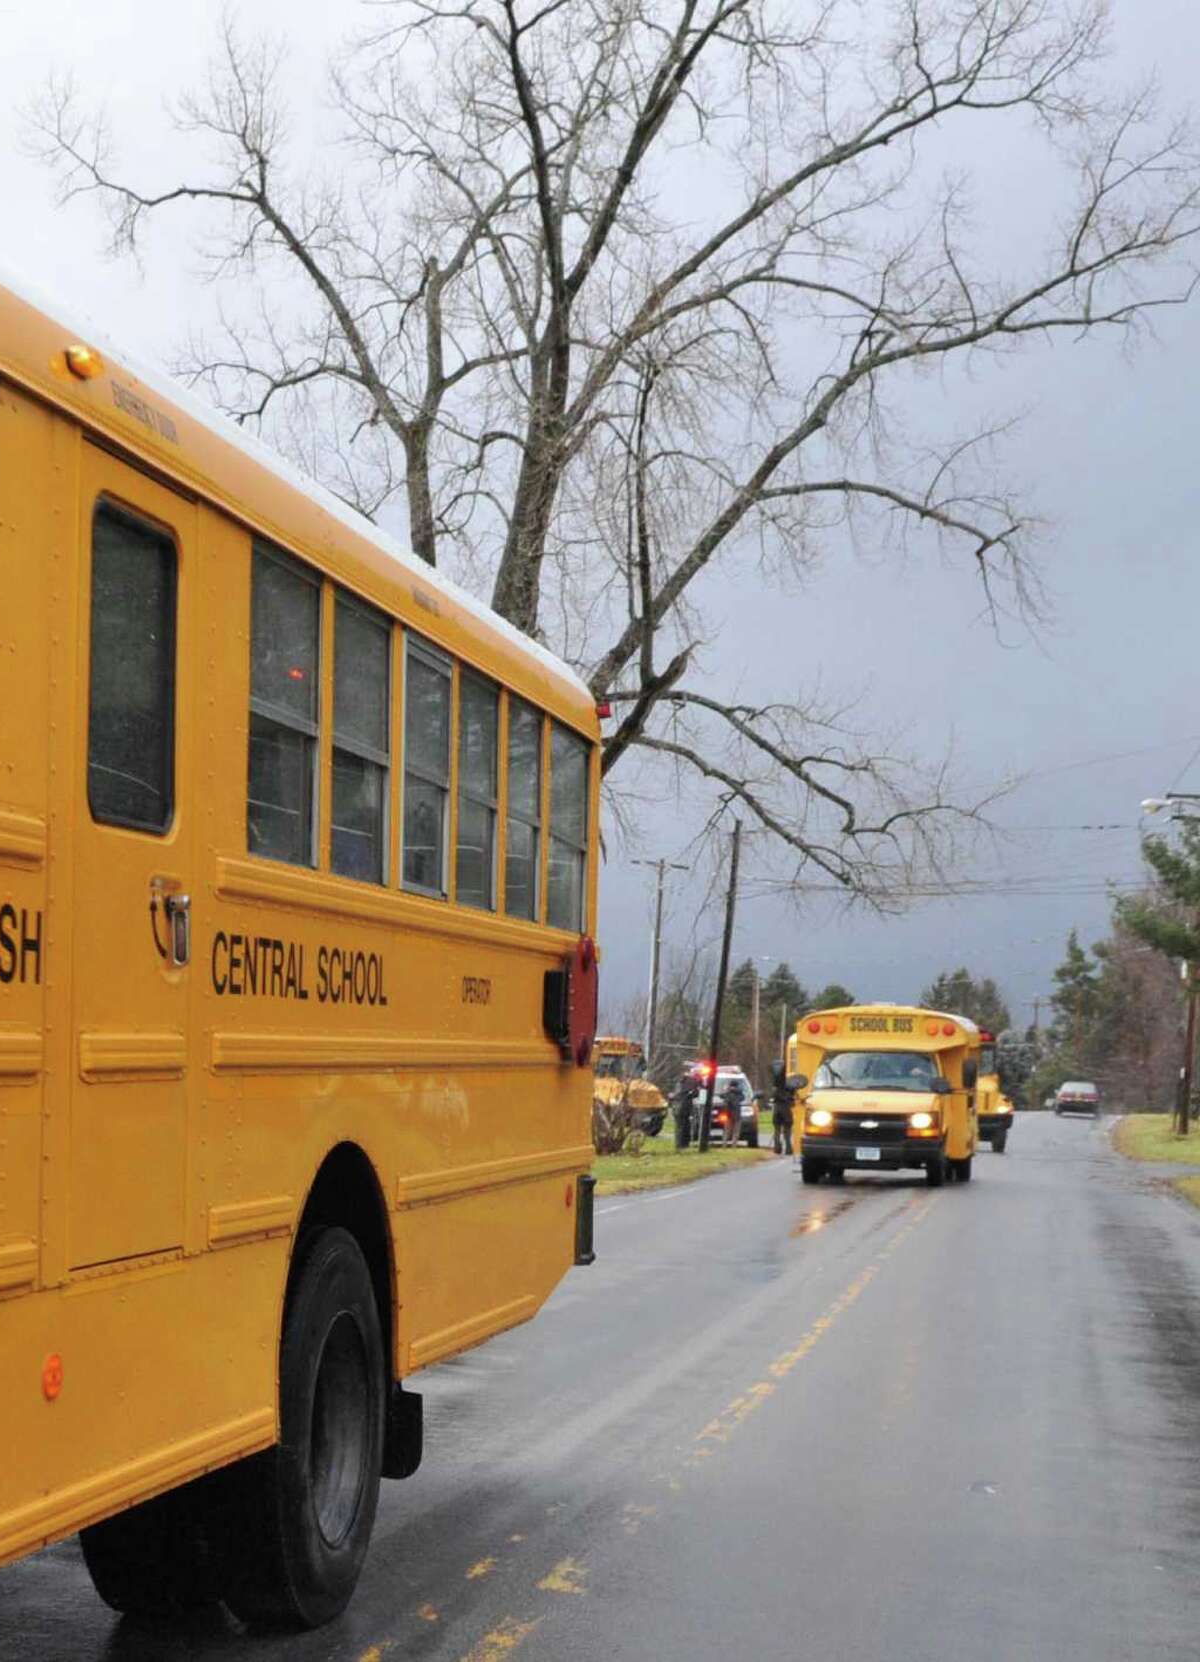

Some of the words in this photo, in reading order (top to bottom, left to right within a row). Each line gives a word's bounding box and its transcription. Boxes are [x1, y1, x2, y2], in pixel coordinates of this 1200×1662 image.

[212, 930, 308, 1000] CENTRAL
[317, 946, 388, 1006] SCHOOL
[850, 1017, 889, 1032] SCHOOL
[892, 1017, 913, 1032] BUS
